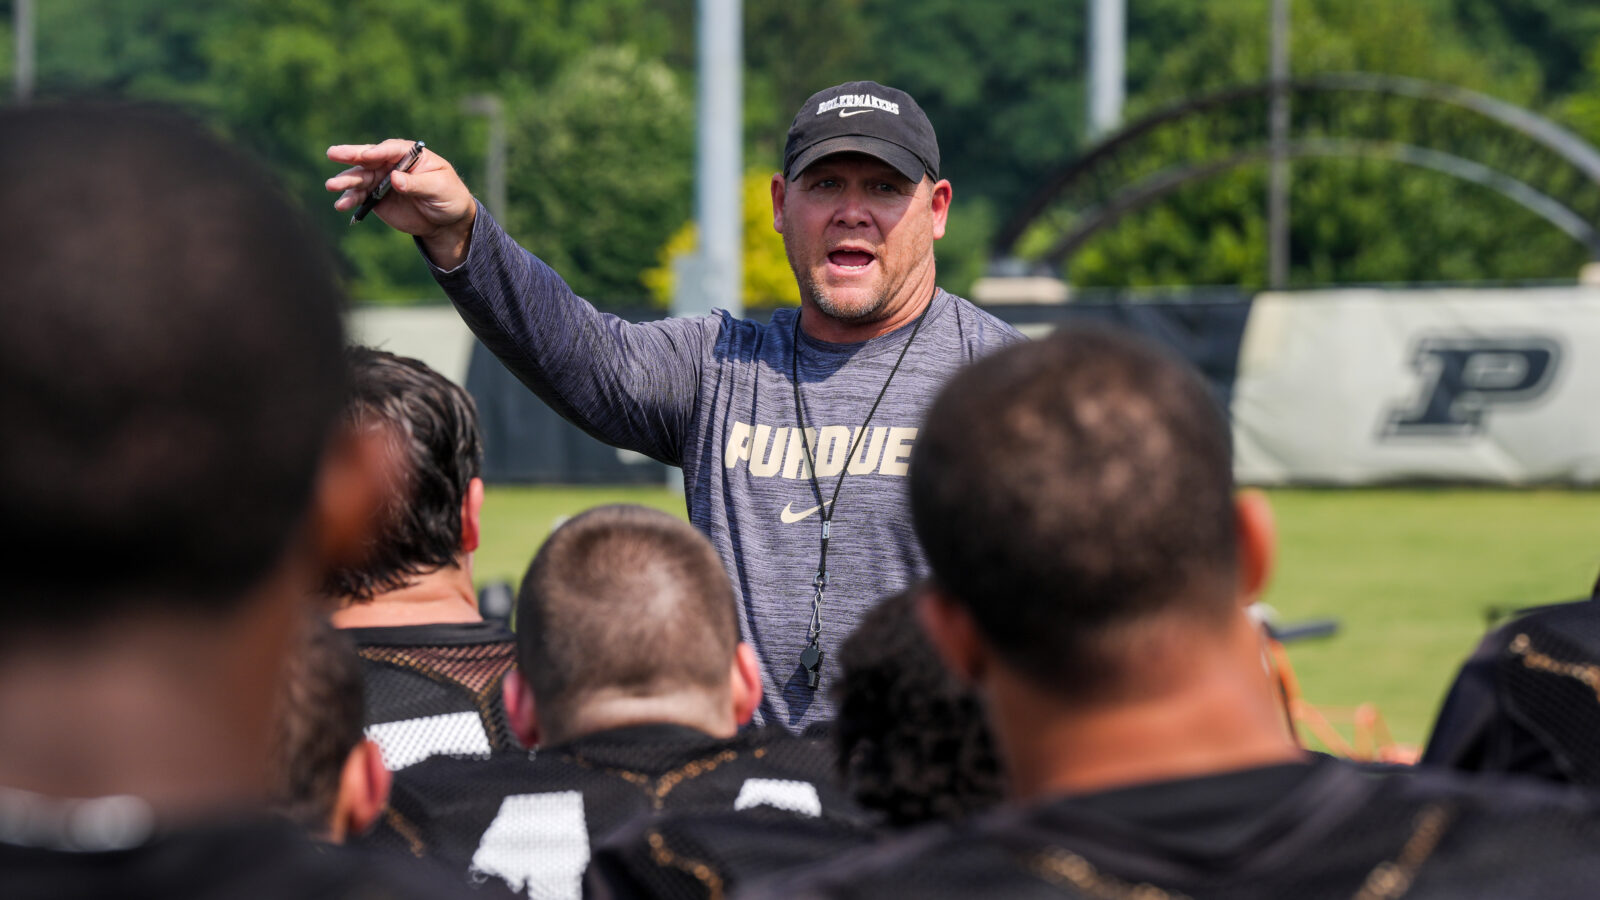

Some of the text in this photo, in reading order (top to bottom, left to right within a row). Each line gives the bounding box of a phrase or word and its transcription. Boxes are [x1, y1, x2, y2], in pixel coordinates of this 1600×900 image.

[816, 94, 900, 115] BOILERMAKERS
[1379, 335, 1562, 438] P
[725, 421, 918, 480] PURDUE
